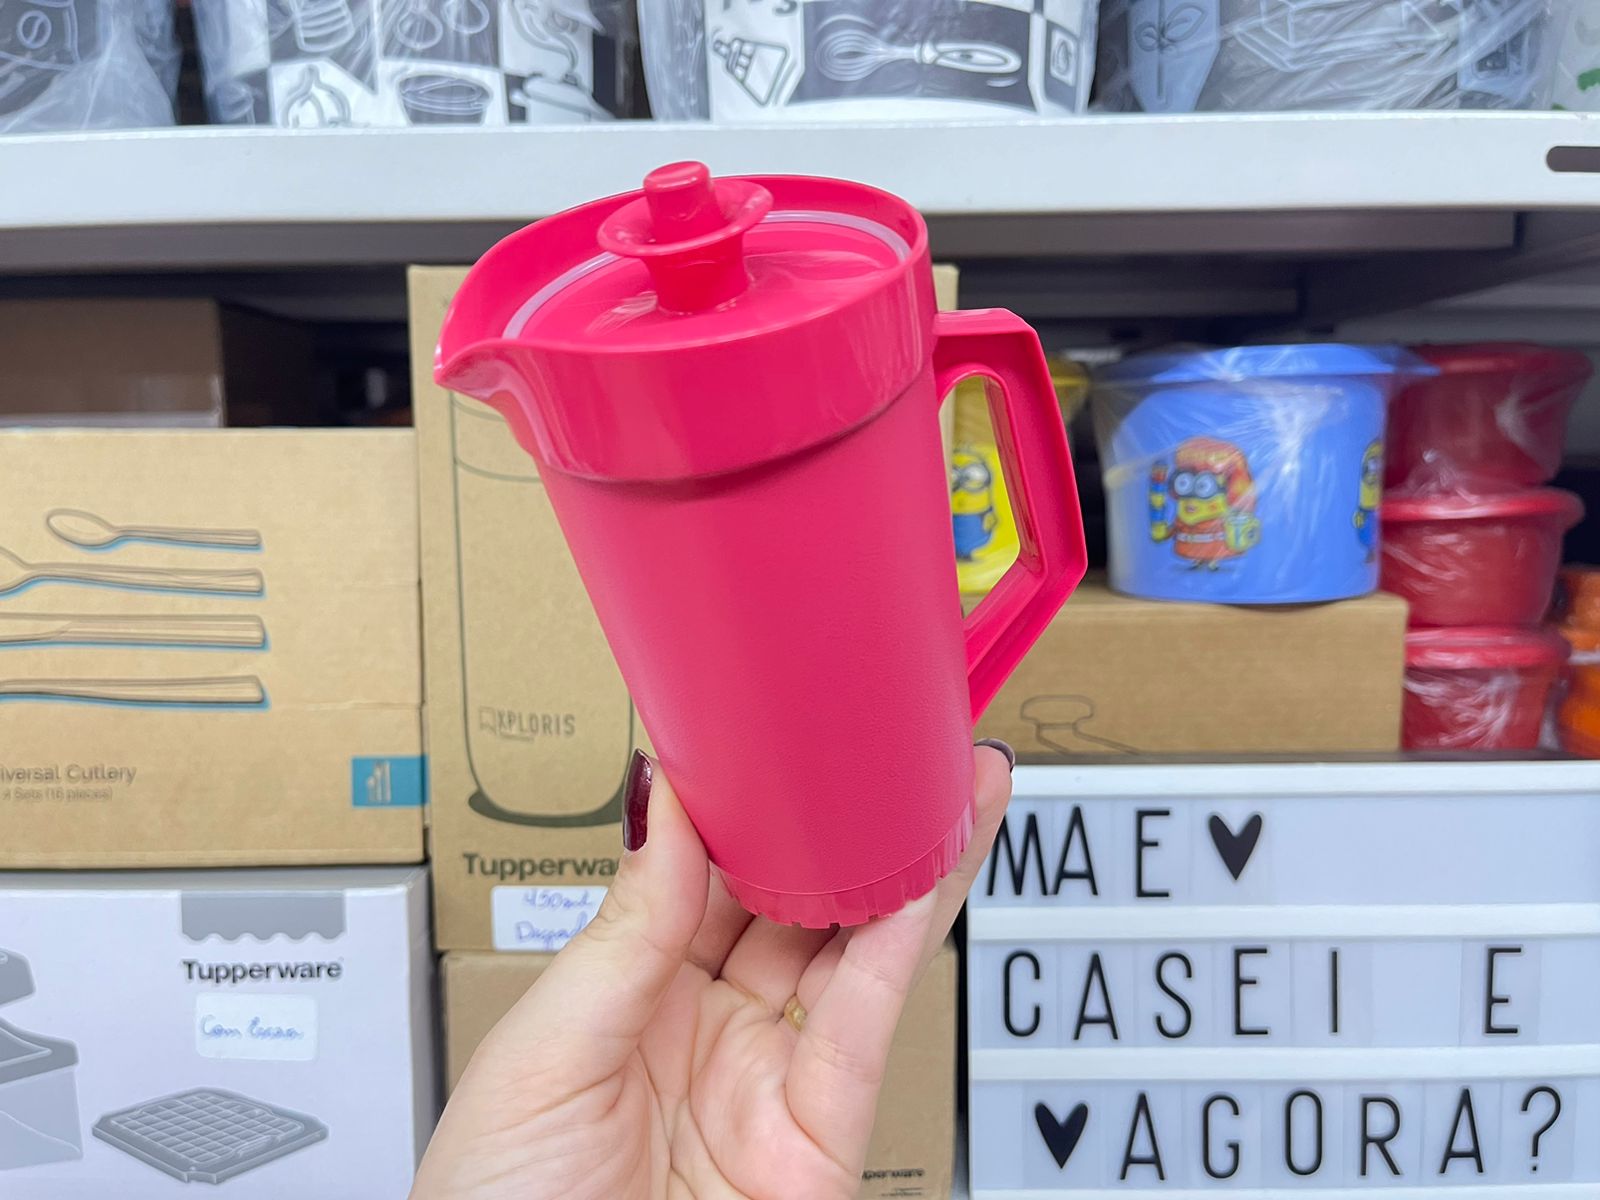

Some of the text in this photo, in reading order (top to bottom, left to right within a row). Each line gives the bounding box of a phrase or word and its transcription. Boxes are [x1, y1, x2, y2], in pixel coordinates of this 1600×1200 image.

[66, 764, 138, 786] Cutlery
[182, 959, 343, 984] Tupperware
[1003, 946, 1523, 1040] CASEI E
[1119, 1085, 1562, 1181] AGORA?
